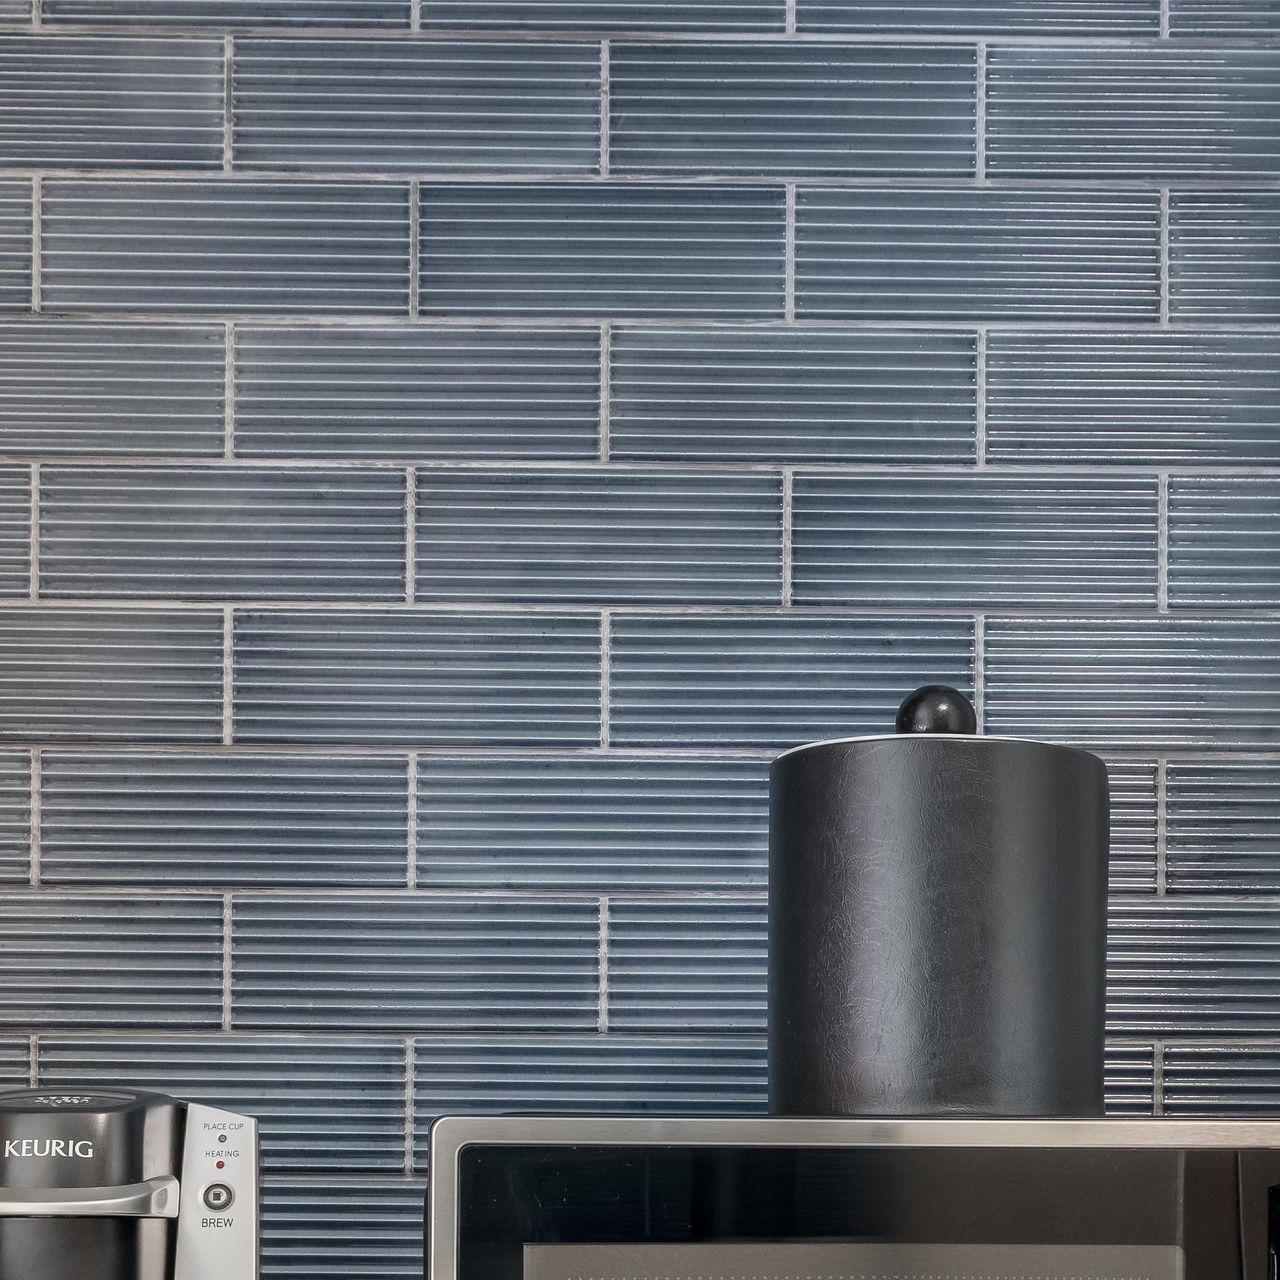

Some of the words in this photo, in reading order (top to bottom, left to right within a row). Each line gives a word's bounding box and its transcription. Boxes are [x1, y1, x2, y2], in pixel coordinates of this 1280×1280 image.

[203, 1123, 227, 1131] PLACE
[228, 1123, 244, 1131] CUP
[3, 1139, 94, 1159] KEURIG
[205, 1150, 240, 1158] HEATING
[201, 1218, 234, 1228] BREW
